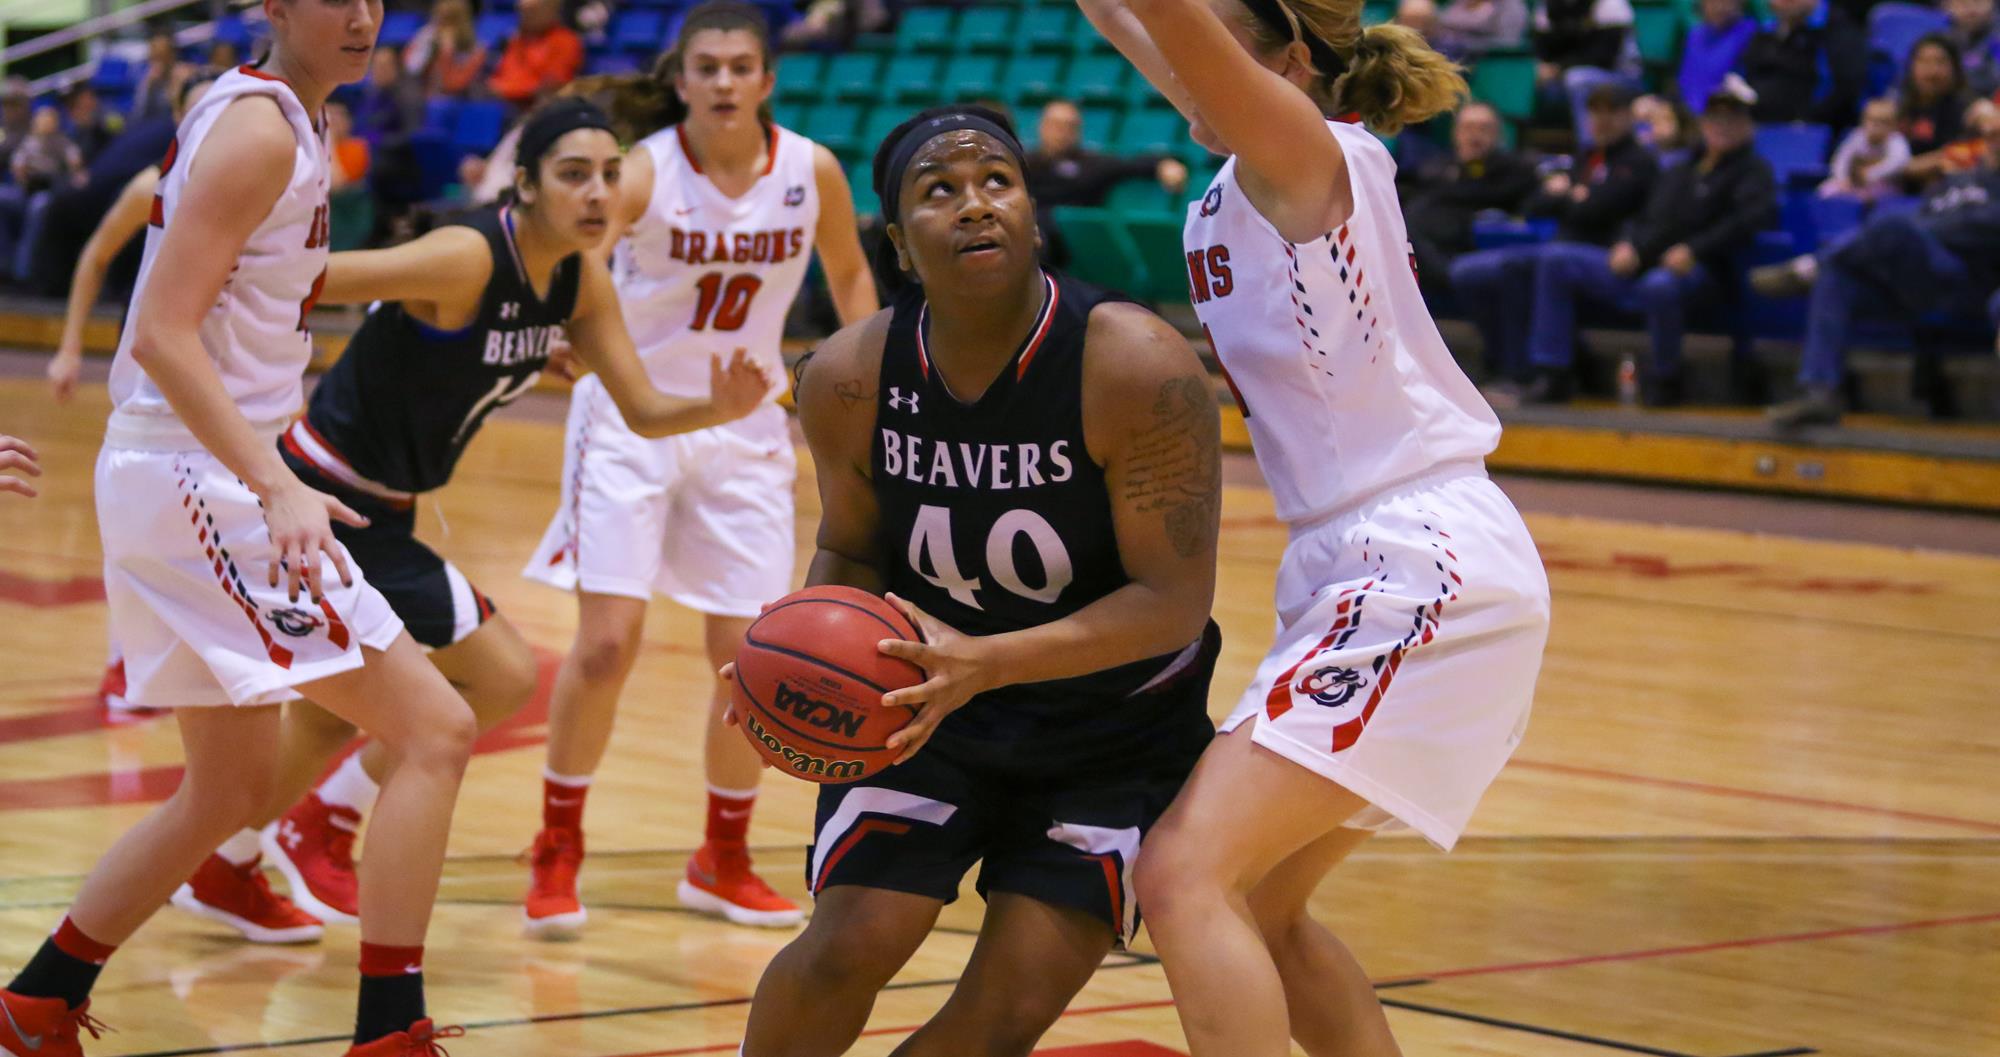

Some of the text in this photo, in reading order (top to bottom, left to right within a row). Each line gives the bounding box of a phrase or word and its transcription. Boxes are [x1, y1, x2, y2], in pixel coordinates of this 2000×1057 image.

[670, 226, 803, 265] DRAGONS
[689, 271, 763, 331] 10
[881, 427, 1073, 490] BEAVERS
[908, 504, 1073, 612] 40
[774, 681, 867, 738] NCAA
[747, 712, 866, 779] Wilson
